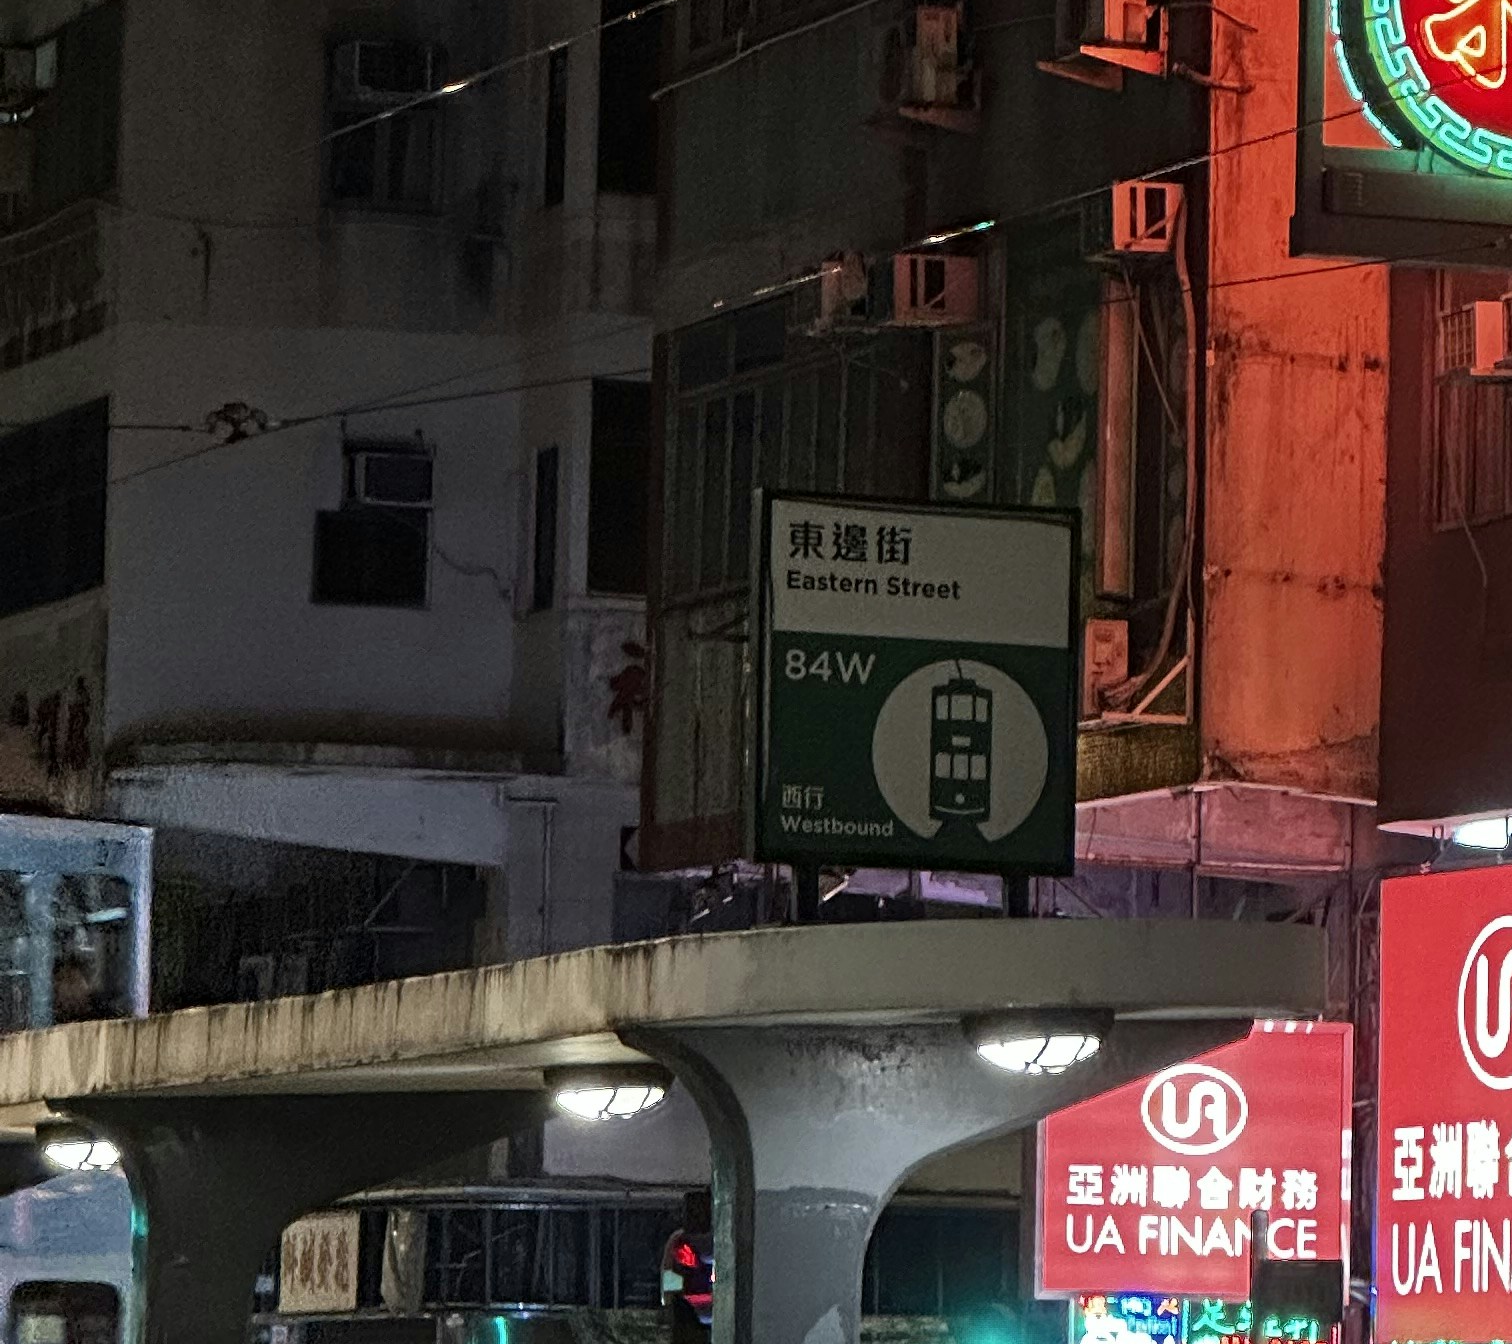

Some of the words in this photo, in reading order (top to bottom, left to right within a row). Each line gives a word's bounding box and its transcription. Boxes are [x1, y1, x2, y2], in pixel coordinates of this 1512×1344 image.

[788, 521, 912, 566] 東邊街
[786, 570, 877, 596] Eastern
[887, 576, 961, 601] Street
[785, 649, 876, 685] 84W
[781, 784, 825, 811] 西行
[781, 814, 894, 838] Westbound
[1067, 1164, 1318, 1210] 亞洲聯合財務
[1066, 1214, 1125, 1254] UA
[1391, 1219, 1442, 1295] UA
